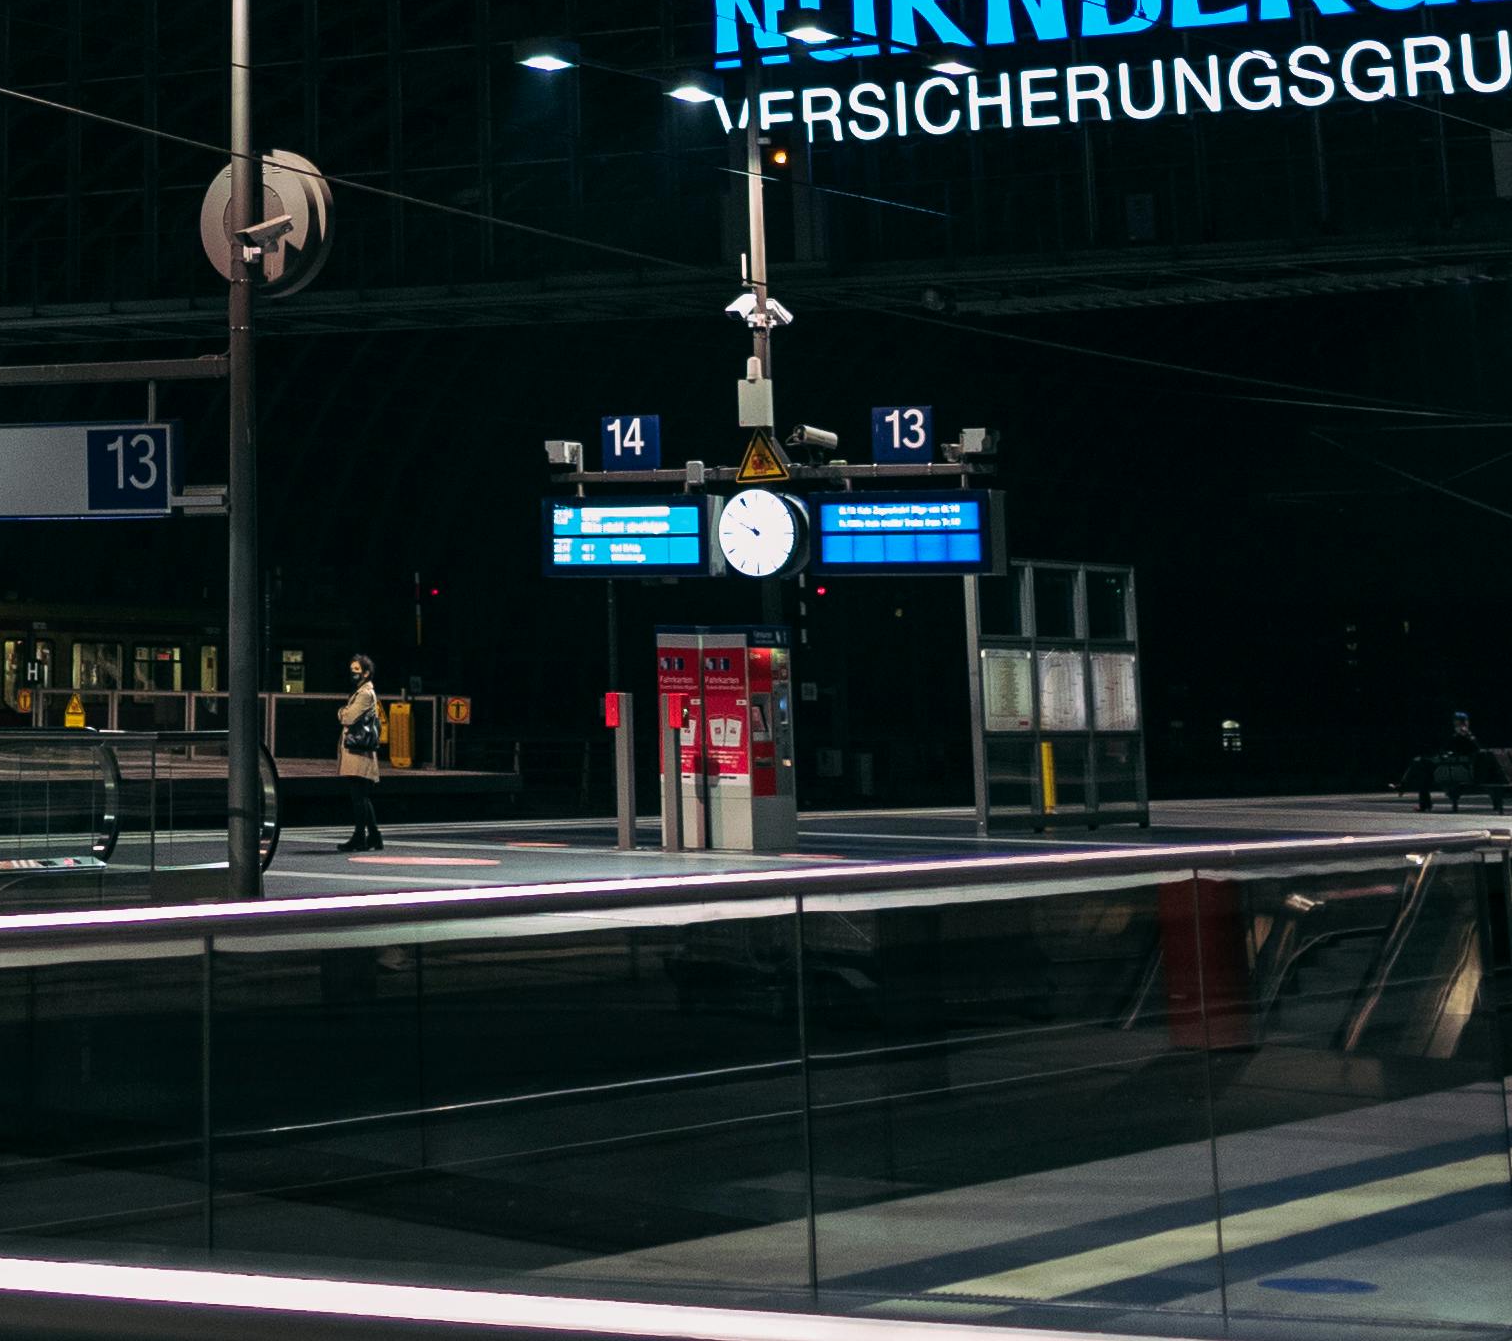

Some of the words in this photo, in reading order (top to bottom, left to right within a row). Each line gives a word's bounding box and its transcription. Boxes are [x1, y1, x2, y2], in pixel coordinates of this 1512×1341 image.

[606, 417, 645, 457] 14
[884, 408, 927, 449] 13
[105, 433, 158, 491] 13
[26, 661, 39, 682] H
